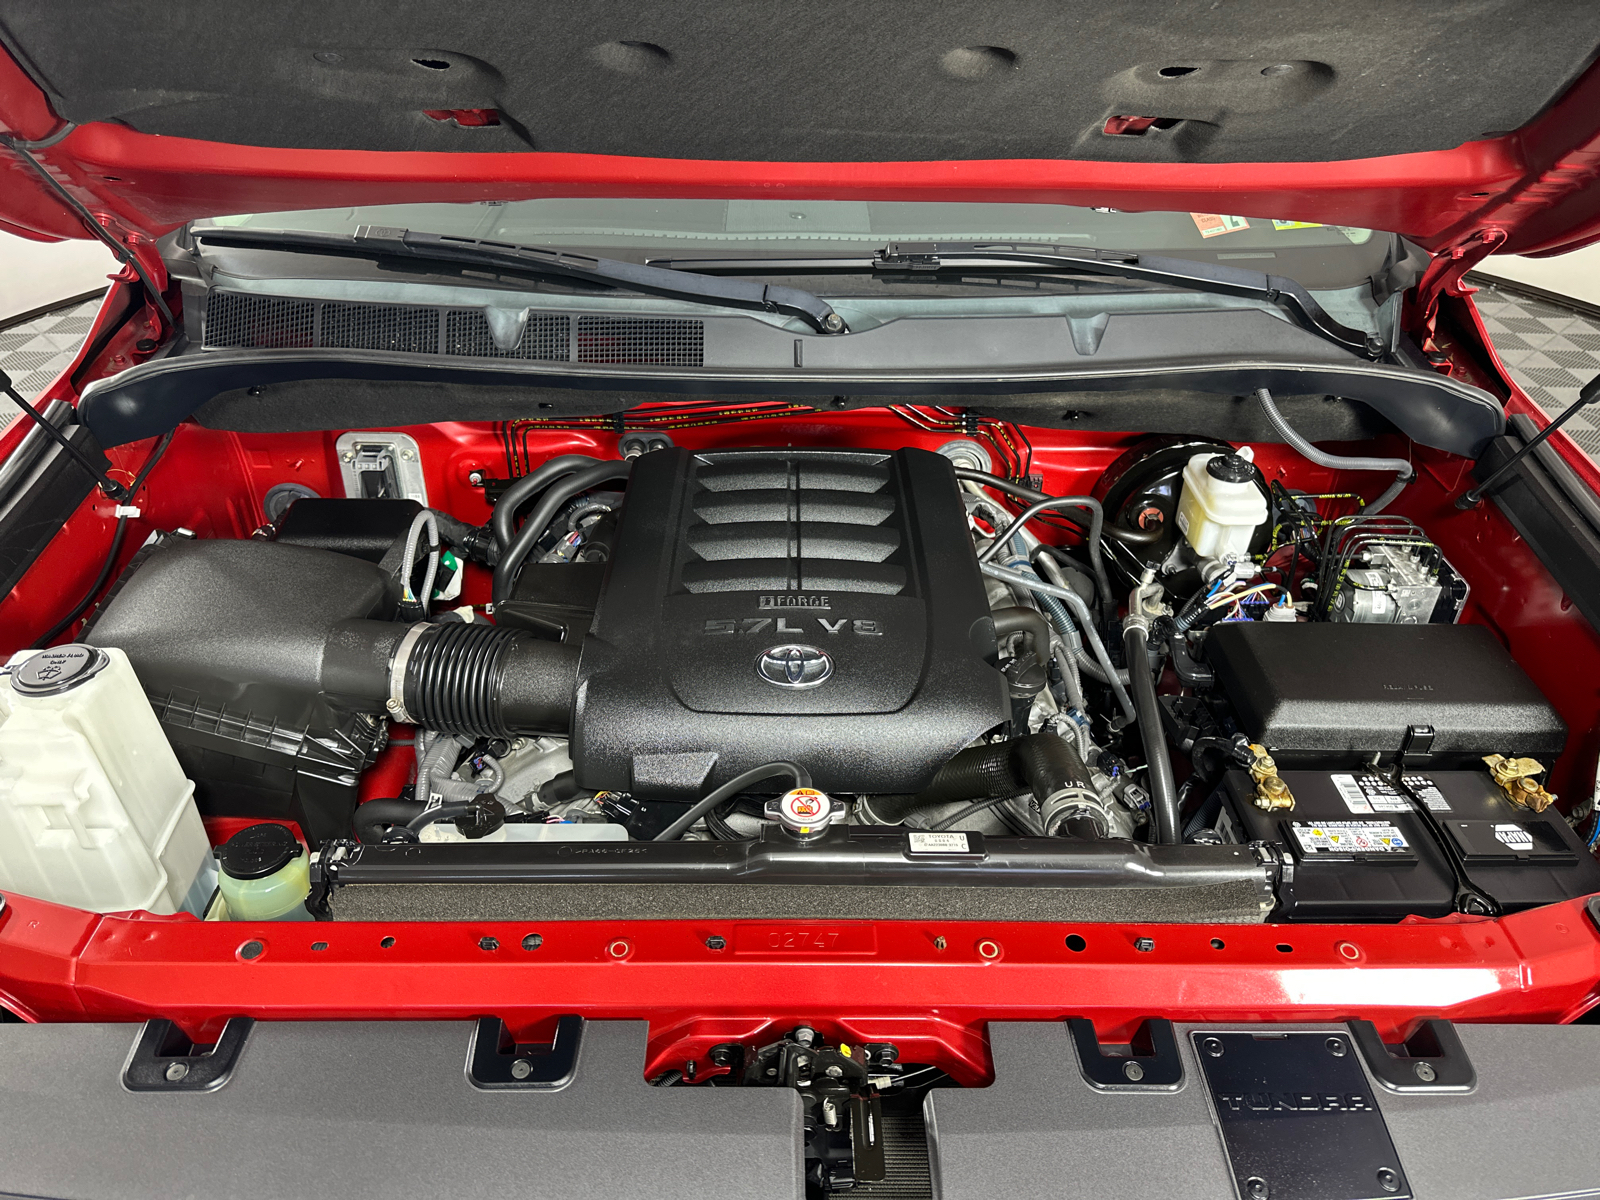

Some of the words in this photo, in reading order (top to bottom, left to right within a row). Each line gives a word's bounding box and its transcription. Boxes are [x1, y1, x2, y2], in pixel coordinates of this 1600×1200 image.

[817, 618, 883, 636] V8
[768, 932, 840, 948] 02747
[1218, 1092, 1373, 1111] TUNDRA
